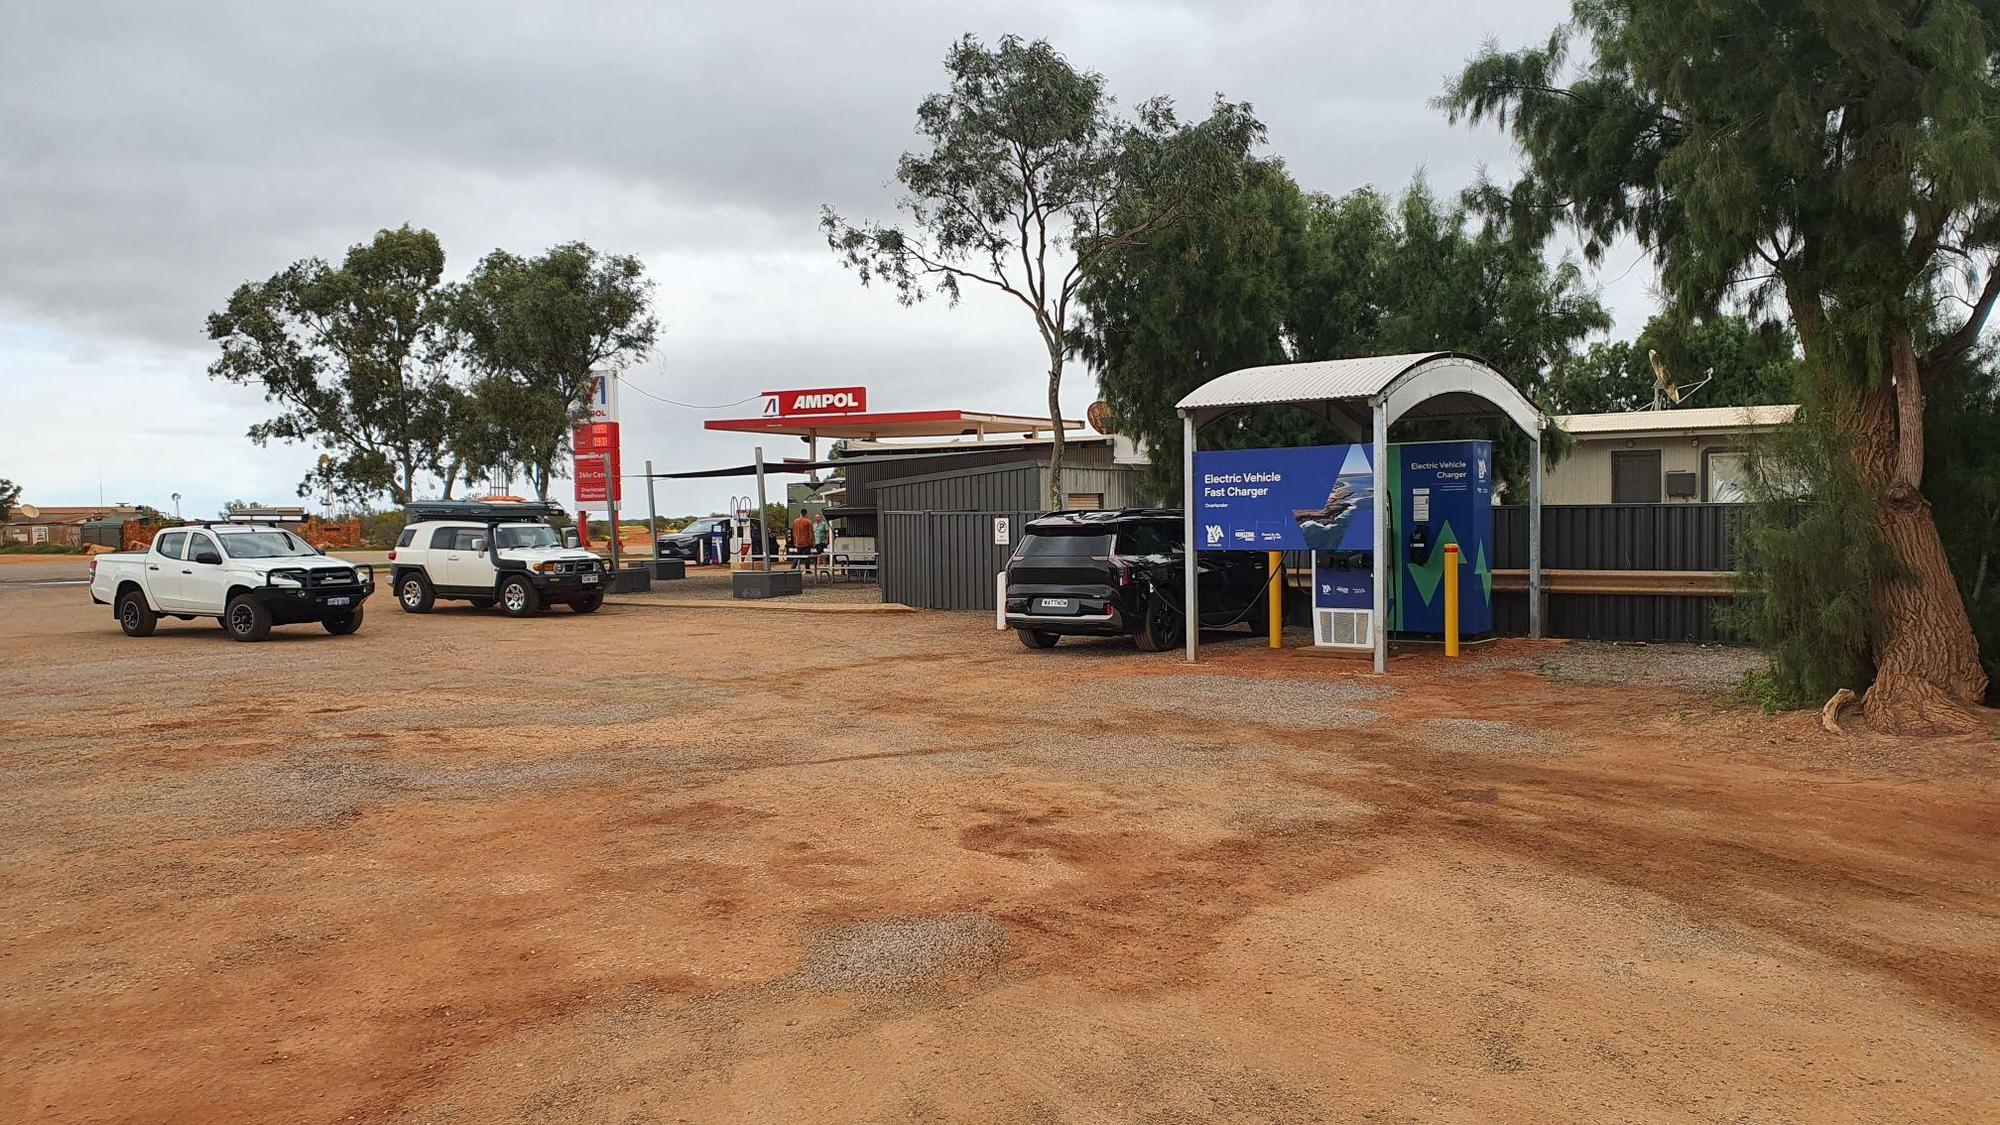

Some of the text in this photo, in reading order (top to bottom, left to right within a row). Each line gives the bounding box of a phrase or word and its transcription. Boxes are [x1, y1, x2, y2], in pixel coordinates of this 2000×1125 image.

[792, 393, 859, 410] AMPOL
[1411, 461, 1467, 470] Electric Vehicle
[1204, 472, 1281, 484] Electric Vehicle
[1436, 471, 1467, 480] Charger
[1204, 486, 1269, 498] Fast Charger
